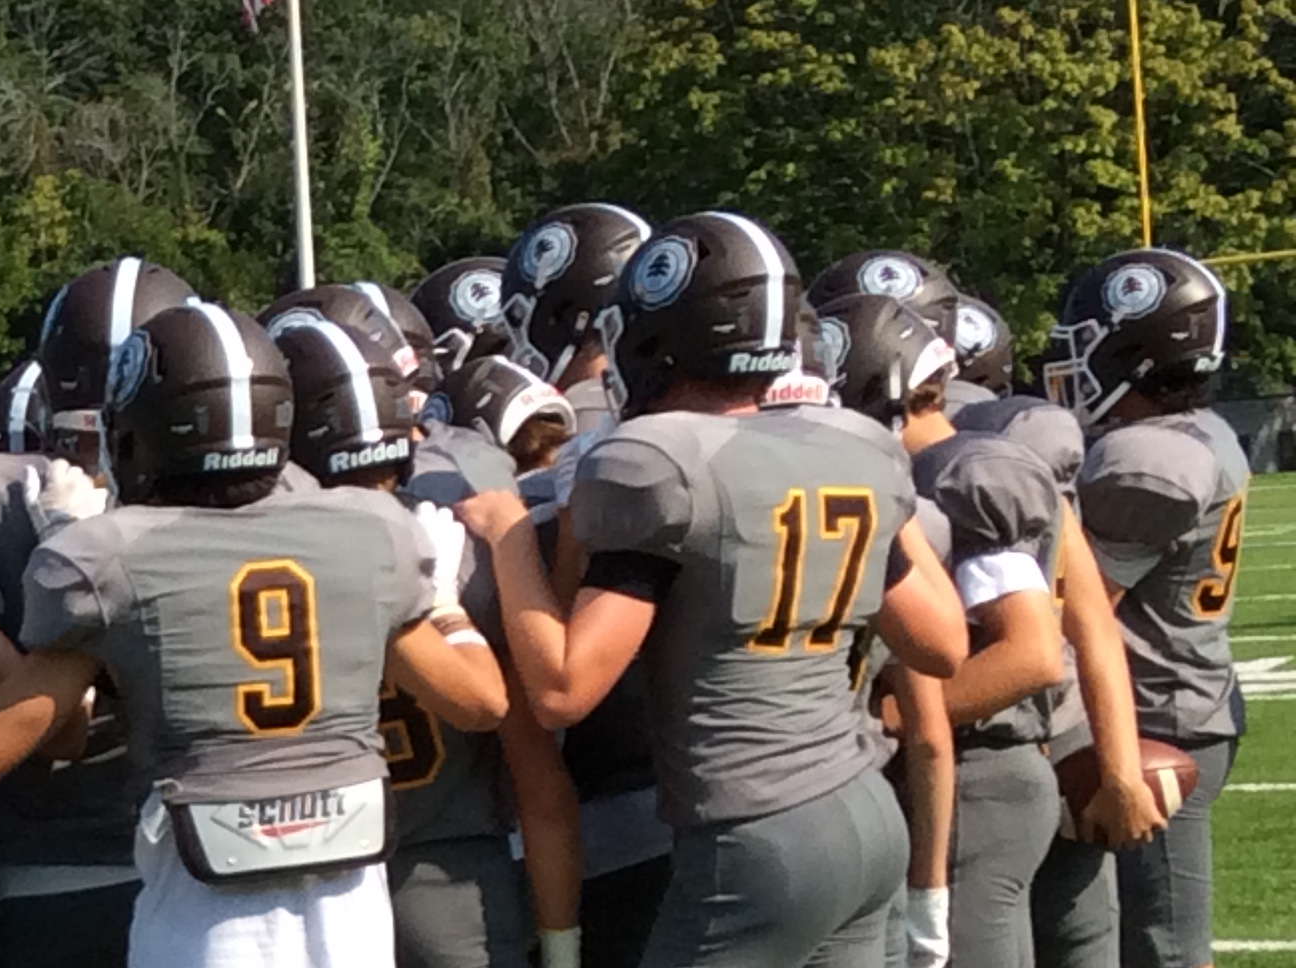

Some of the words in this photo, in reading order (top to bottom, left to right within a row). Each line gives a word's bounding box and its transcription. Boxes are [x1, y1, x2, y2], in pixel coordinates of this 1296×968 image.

[204, 447, 280, 471] Riddell
[329, 438, 410, 473] Riddell
[744, 483, 878, 655] 17
[229, 559, 324, 739] 9
